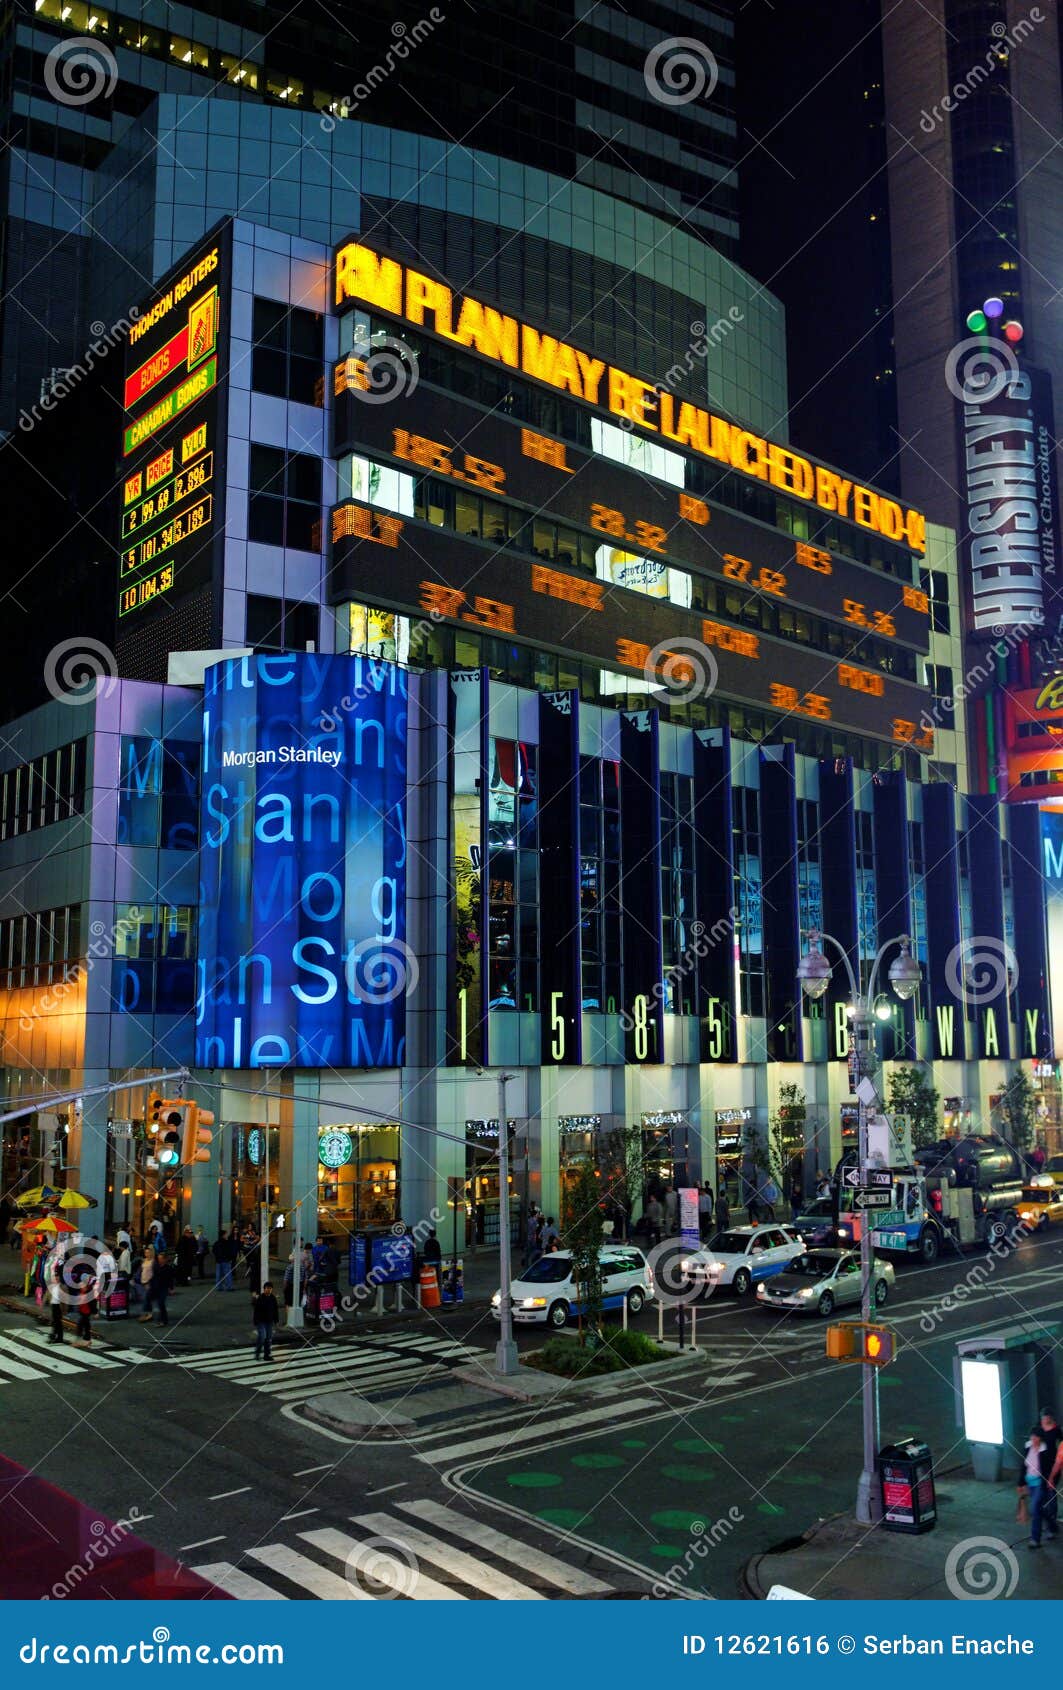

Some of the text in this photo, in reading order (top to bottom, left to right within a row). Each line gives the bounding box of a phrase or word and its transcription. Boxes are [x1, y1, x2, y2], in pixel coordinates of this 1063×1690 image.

[129, 248, 218, 345] THOMSON REUTERS
[140, 350, 170, 391] BONDS
[130, 368, 208, 447] CANADIAN BONDS
[608, 365, 658, 431] BE
[816, 466, 853, 517] BY
[148, 453, 172, 489] PRICE
[1037, 424, 1055, 521] Chocolate
[129, 510, 137, 530] 2
[963, 369, 1044, 630] HERSHEY'S
[128, 549, 136, 569] 5
[124, 587, 137, 611] 10
[223, 746, 342, 767] Morgan Stanley
